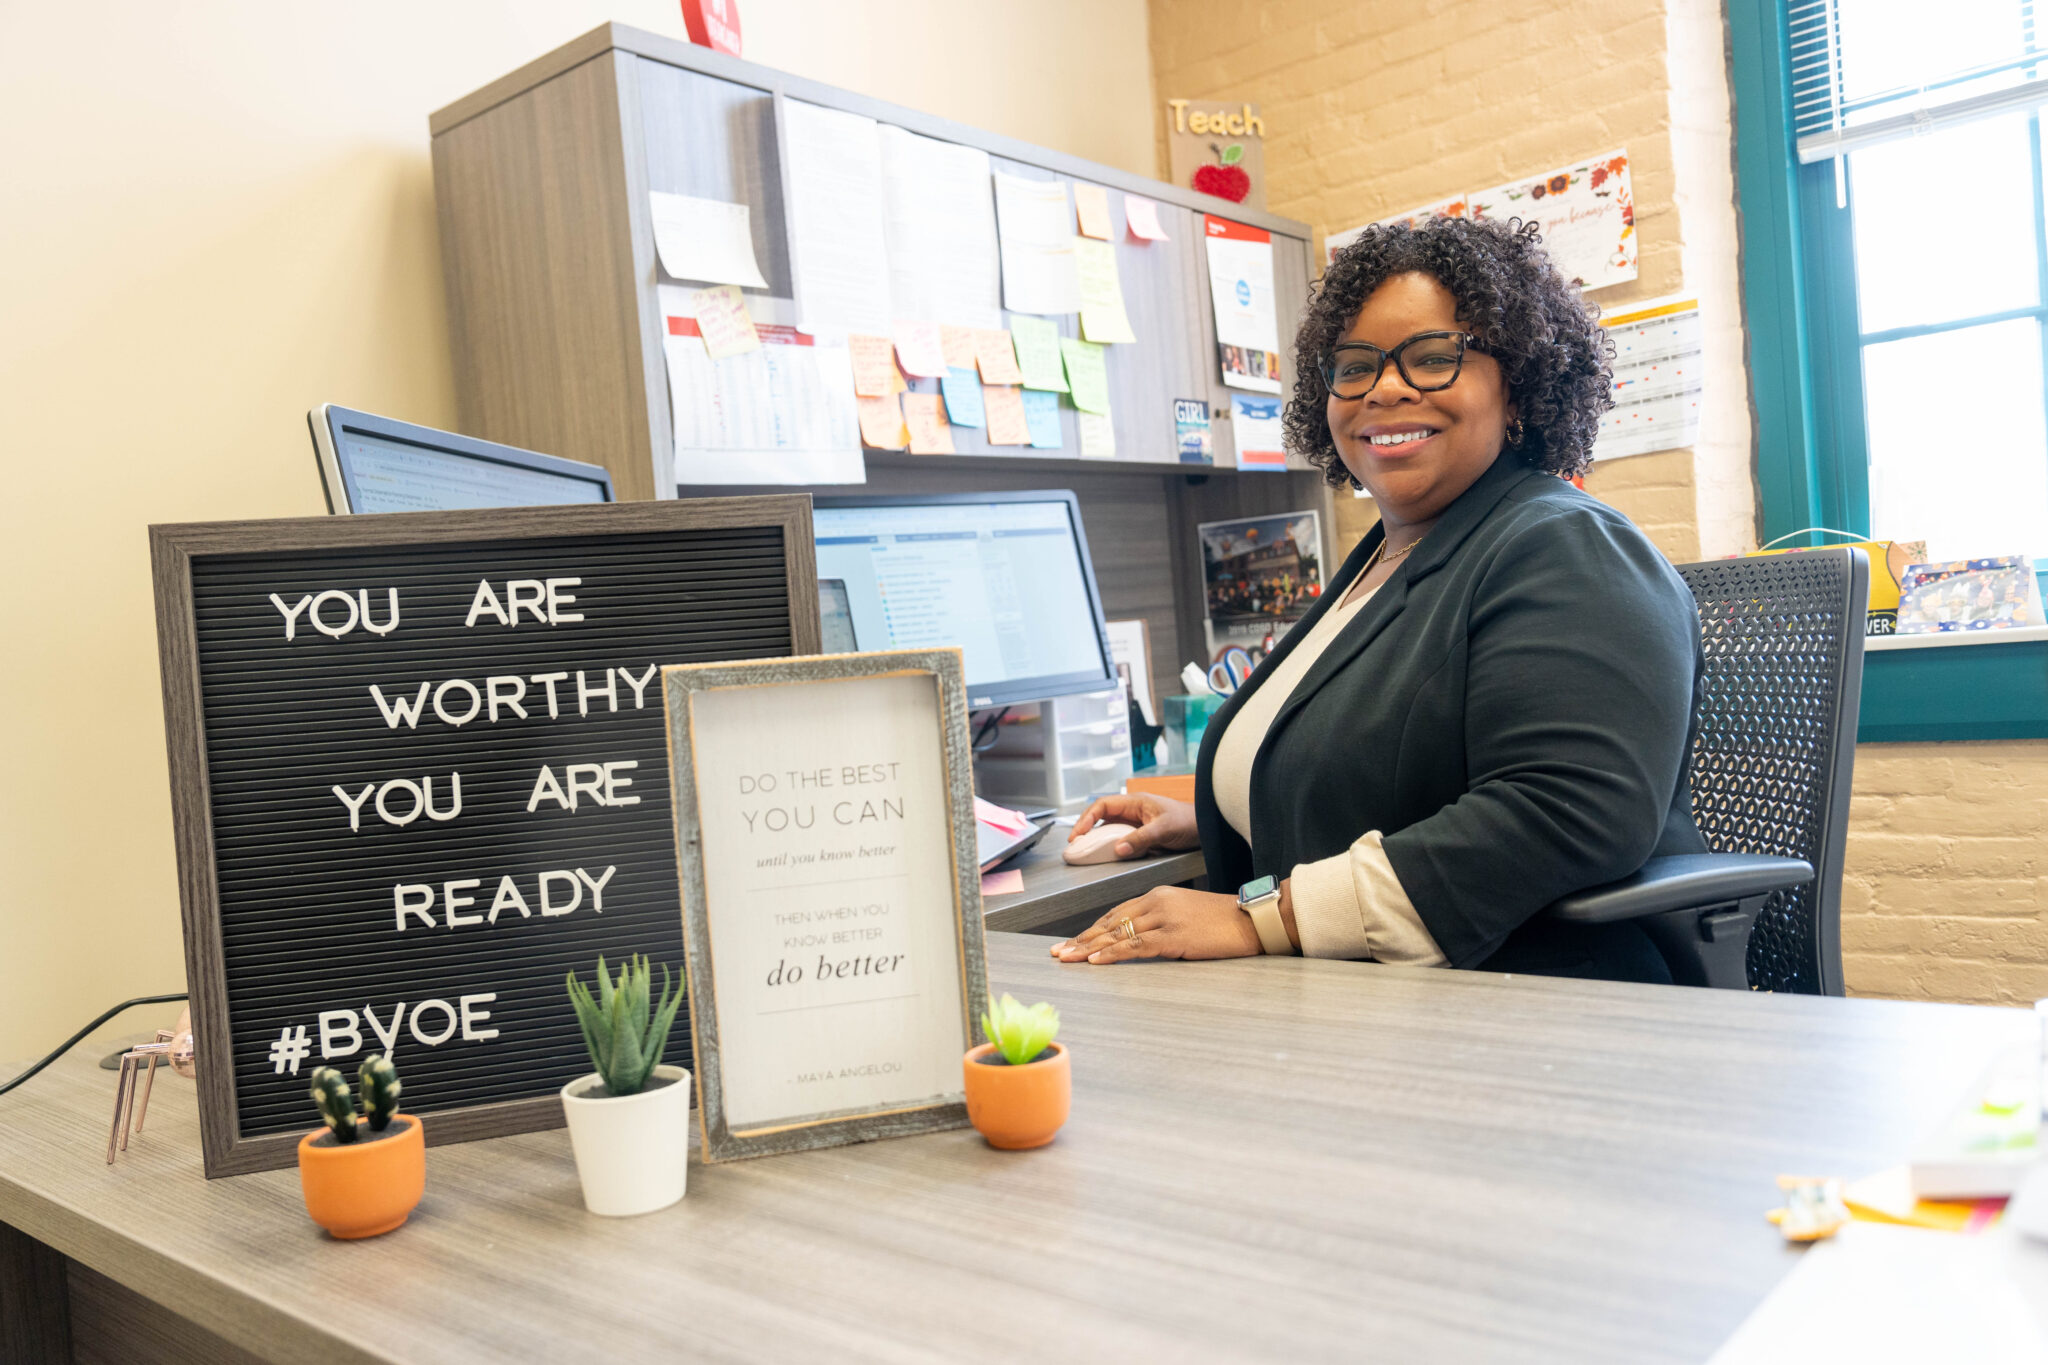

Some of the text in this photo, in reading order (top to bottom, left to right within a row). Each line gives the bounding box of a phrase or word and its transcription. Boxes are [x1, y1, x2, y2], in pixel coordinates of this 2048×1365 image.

[1168, 99, 1265, 137] Teach
[1175, 401, 1212, 424] GIRL
[269, 577, 585, 641] YOU ARE
[369, 663, 657, 729] WORTHY
[739, 762, 900, 795] DO THE BEST
[332, 761, 641, 832] YOU ARE
[742, 796, 905, 834] YOU CAN
[756, 844, 897, 868] until you know better
[394, 865, 617, 932] READY
[774, 903, 890, 926] THEN WHEN YOU
[784, 927, 883, 949] KNOW BETTER
[766, 952, 905, 987] do better
[797, 1070, 834, 1084] MAYA
[840, 1062, 903, 1079] ANGELOU
